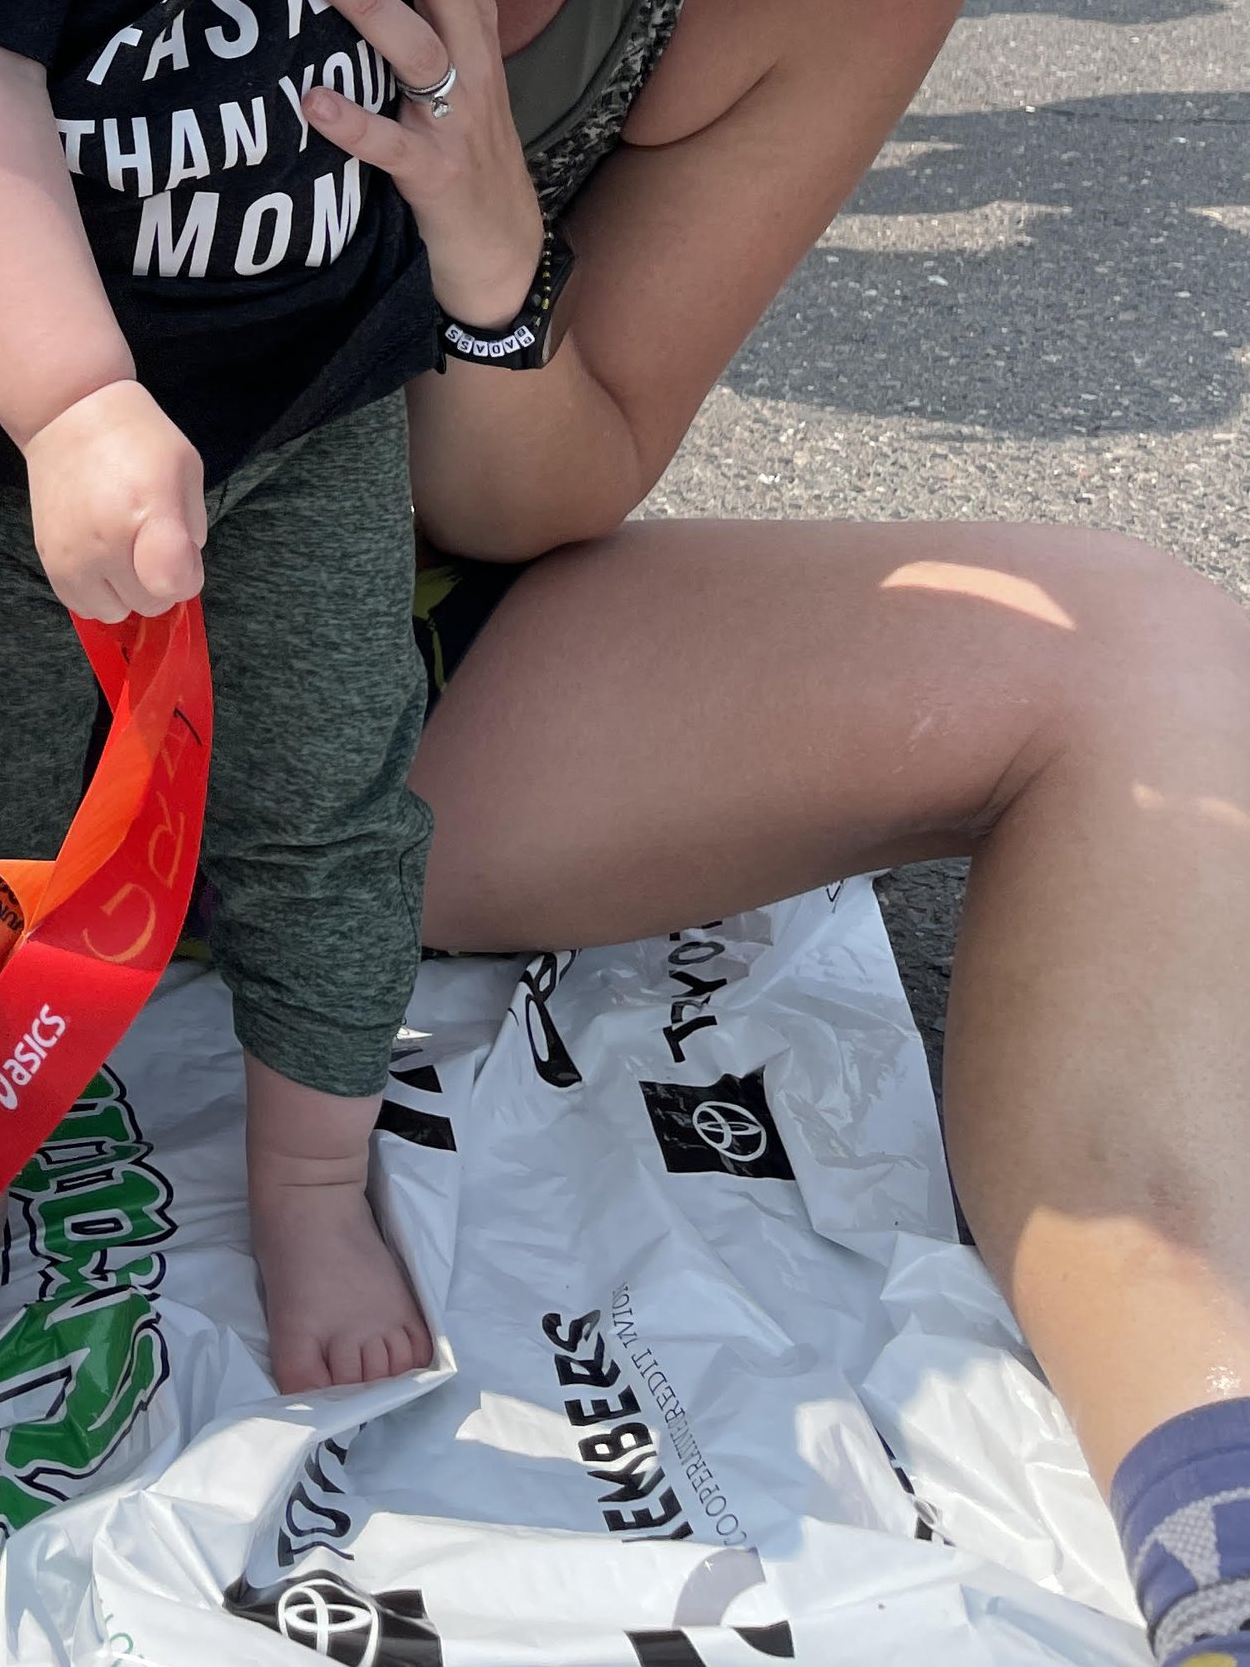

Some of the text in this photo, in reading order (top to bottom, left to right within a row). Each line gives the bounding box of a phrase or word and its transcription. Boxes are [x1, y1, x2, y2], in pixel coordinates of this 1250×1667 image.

[55, 39, 396, 197] THAN YOU
[131, 156, 362, 278] MOM
[446, 326, 534, 356] BADASS
[661, 919, 729, 1064] TOYO
[541, 1308, 694, 1544] EMBERS
